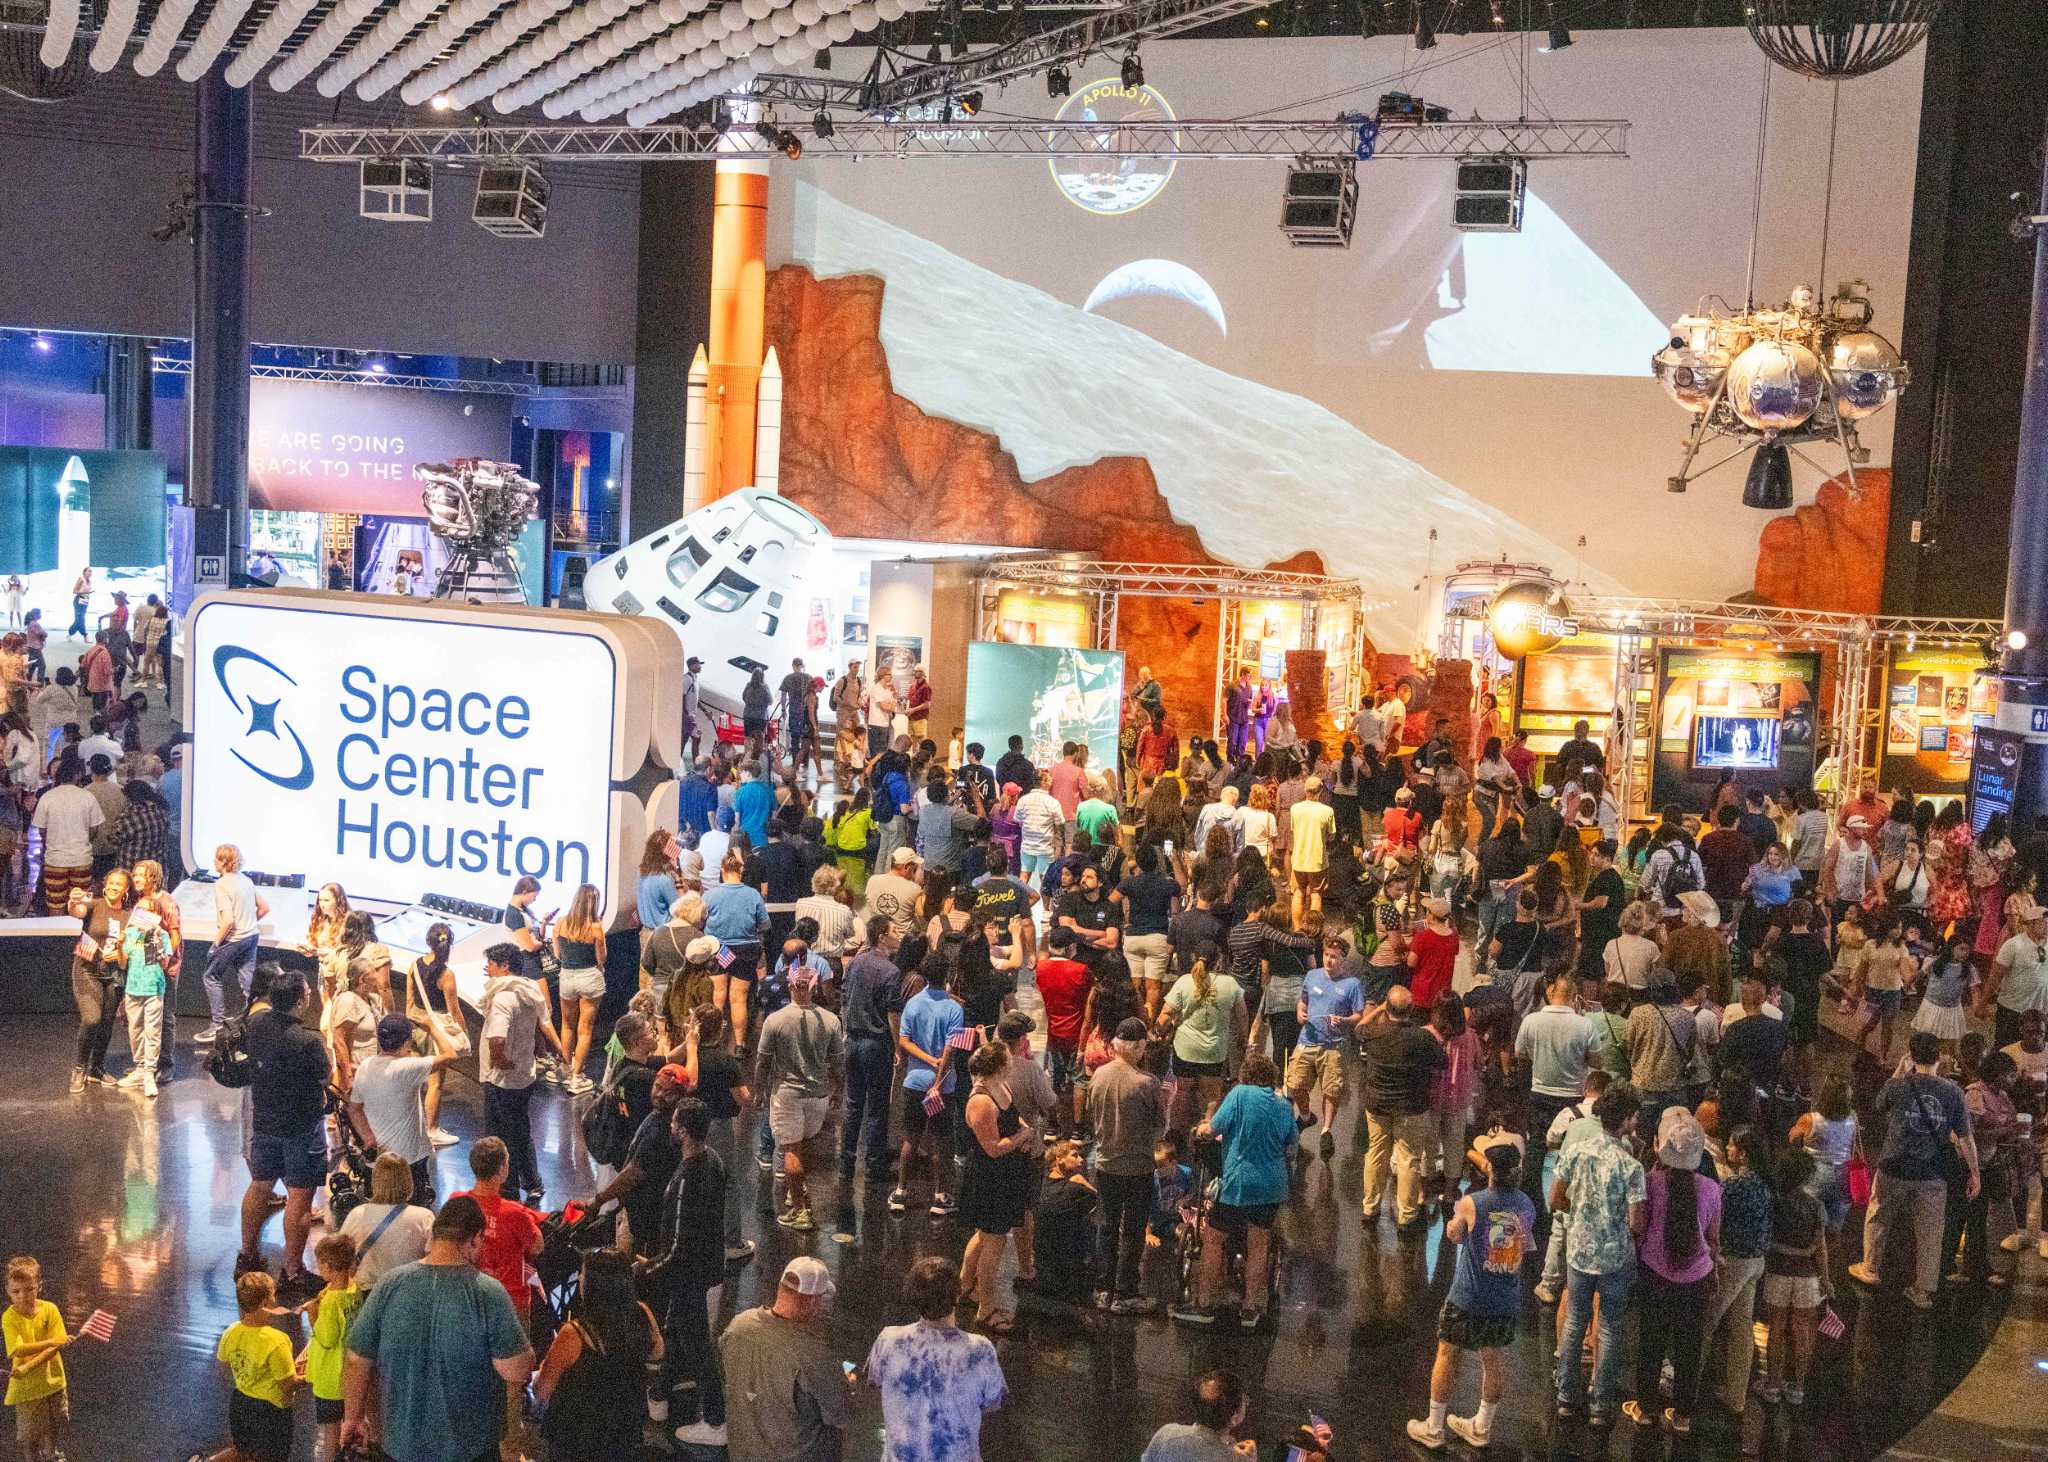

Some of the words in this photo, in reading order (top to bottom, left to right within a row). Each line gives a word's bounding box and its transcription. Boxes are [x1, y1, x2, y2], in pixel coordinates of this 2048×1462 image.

[1083, 85, 1138, 106] APOLLO
[279, 432, 322, 451] ARE
[331, 434, 405, 455] GOING
[254, 455, 313, 477] BACK
[320, 459, 350, 478] TO
[359, 462, 403, 481] THE
[339, 664, 530, 739] Space
[336, 733, 544, 809] Center
[1978, 770, 2006, 785] Lunar
[1976, 781, 2014, 801] Landing
[336, 798, 590, 884] Houston
